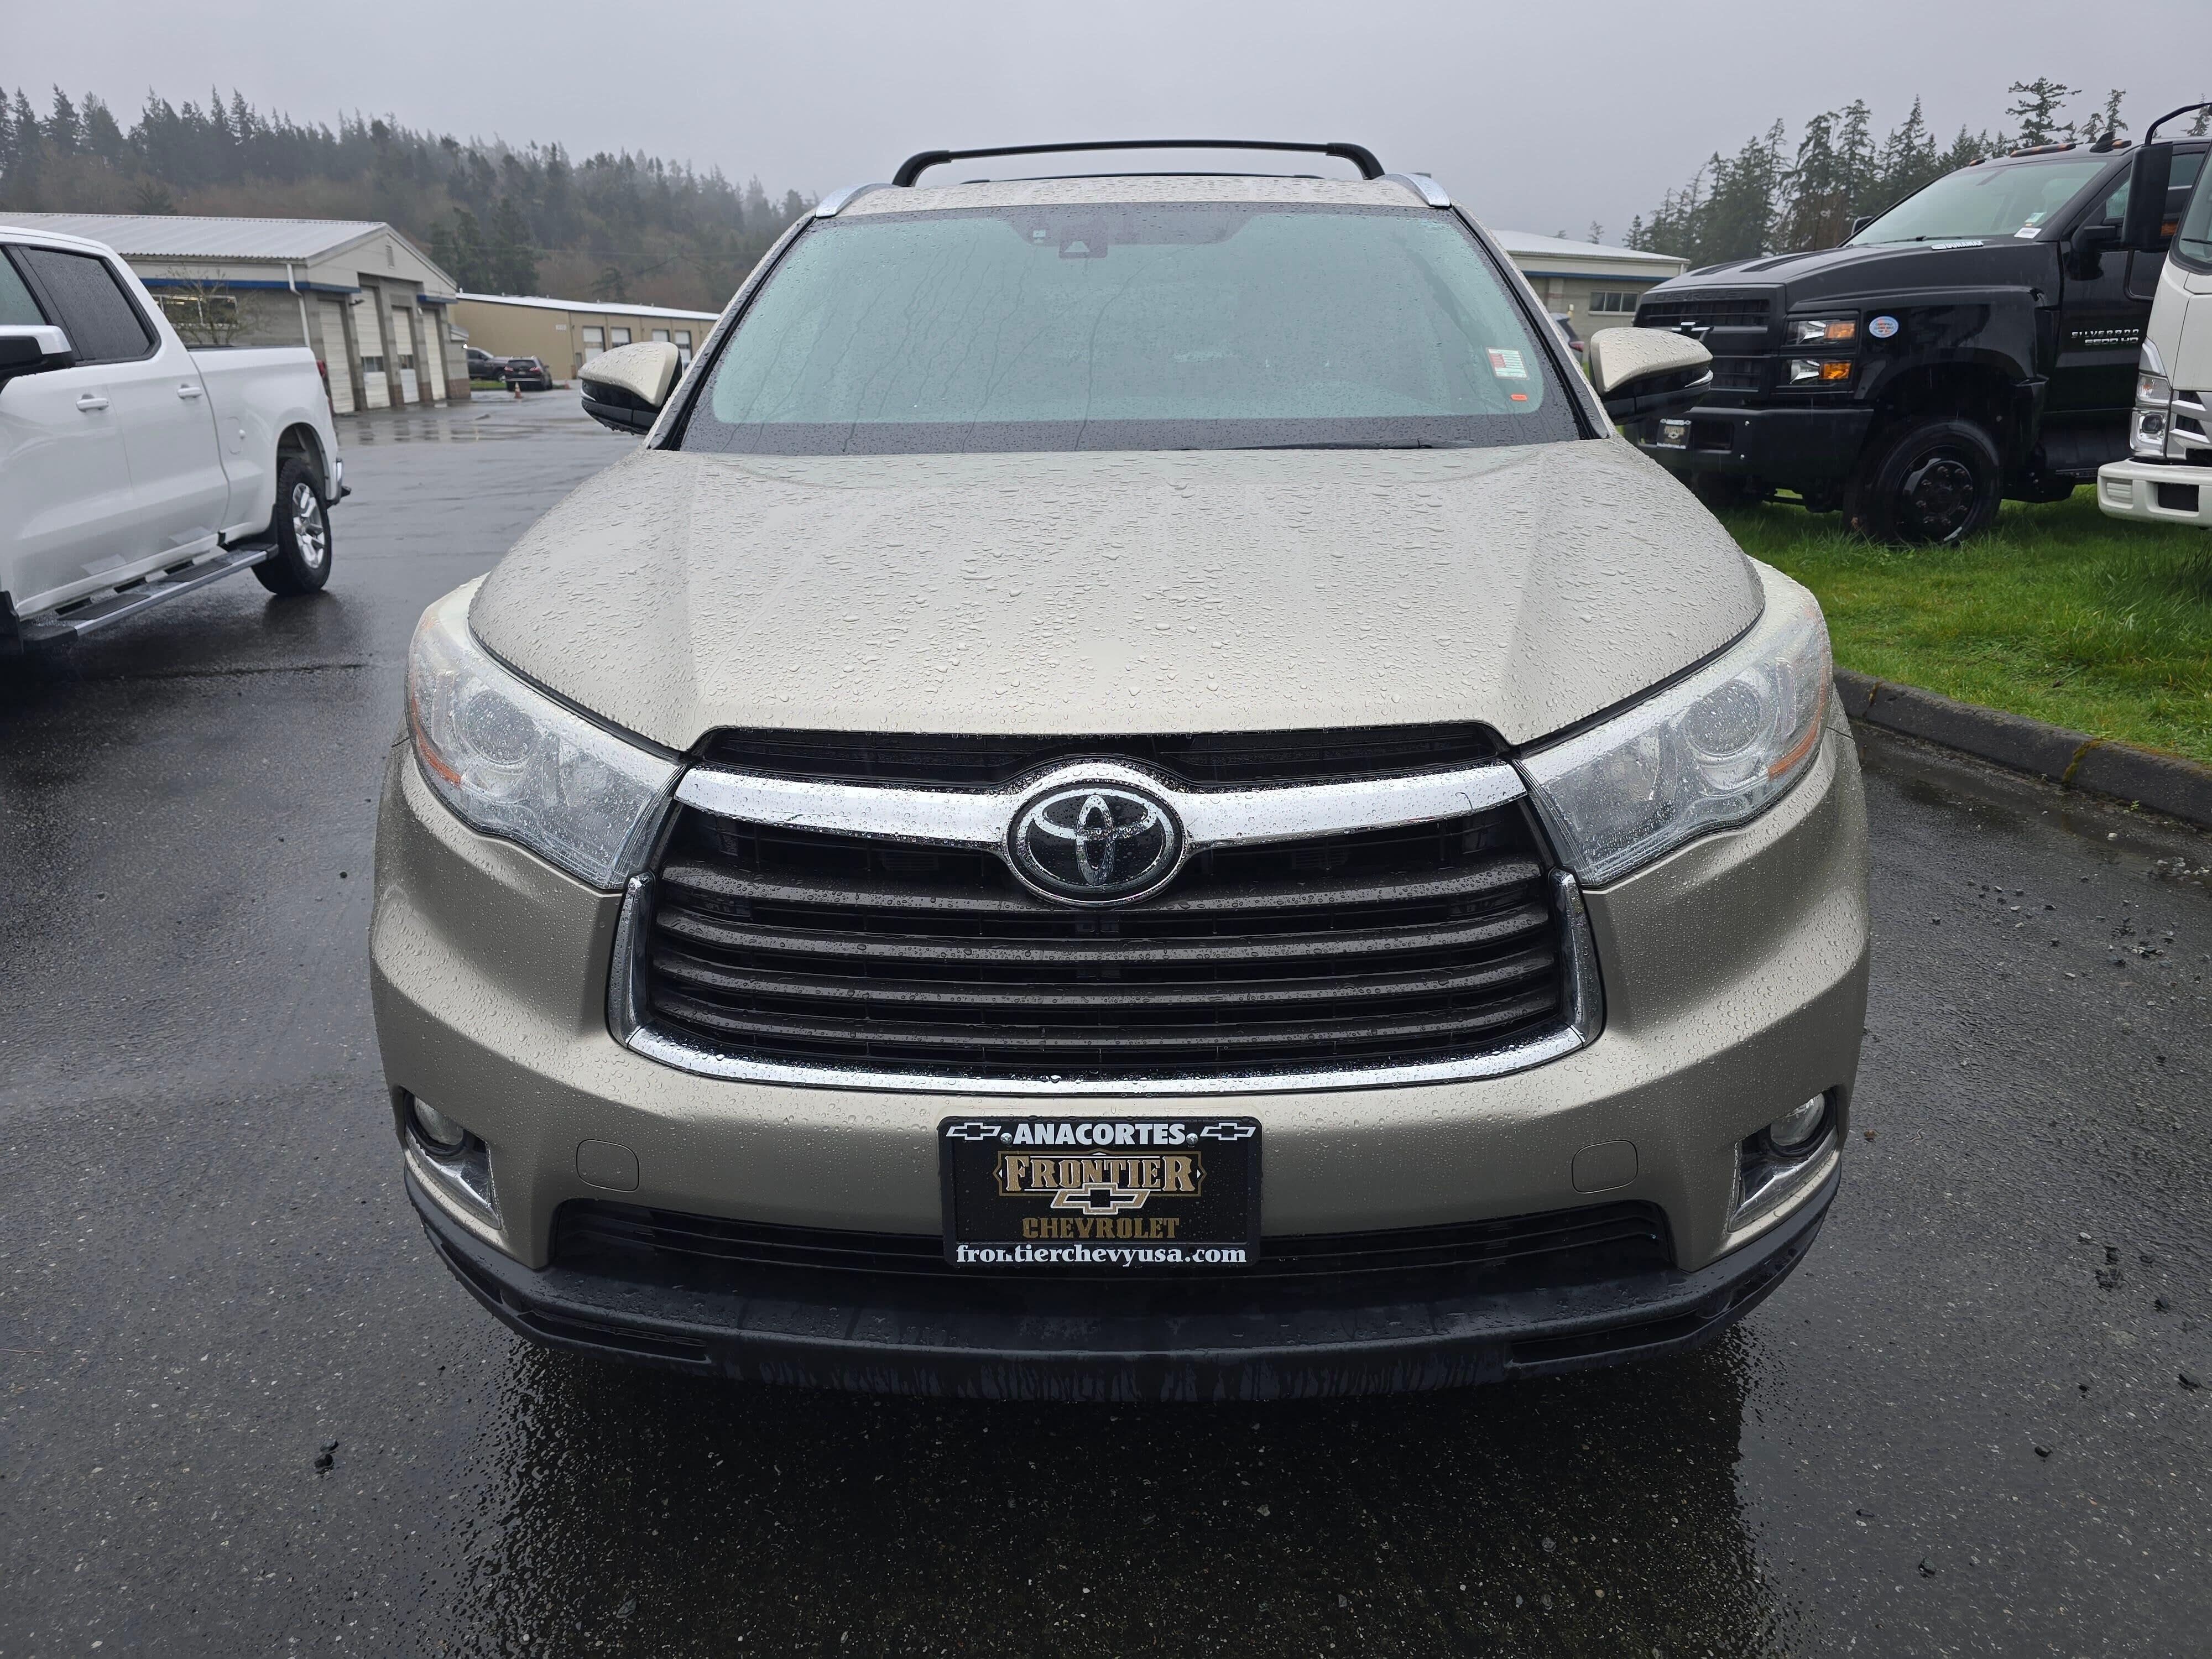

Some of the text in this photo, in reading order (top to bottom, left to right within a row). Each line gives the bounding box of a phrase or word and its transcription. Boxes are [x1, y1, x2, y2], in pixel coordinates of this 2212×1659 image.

[2071, 329, 2139, 338] SILVERADO
[1013, 1123, 1186, 1145] ANACORTES
[1005, 1155, 1196, 1192] FRONTIER
[1022, 1217, 1180, 1239] CHEVROLET
[956, 1244, 1247, 1267] frontierchevyusa.com
